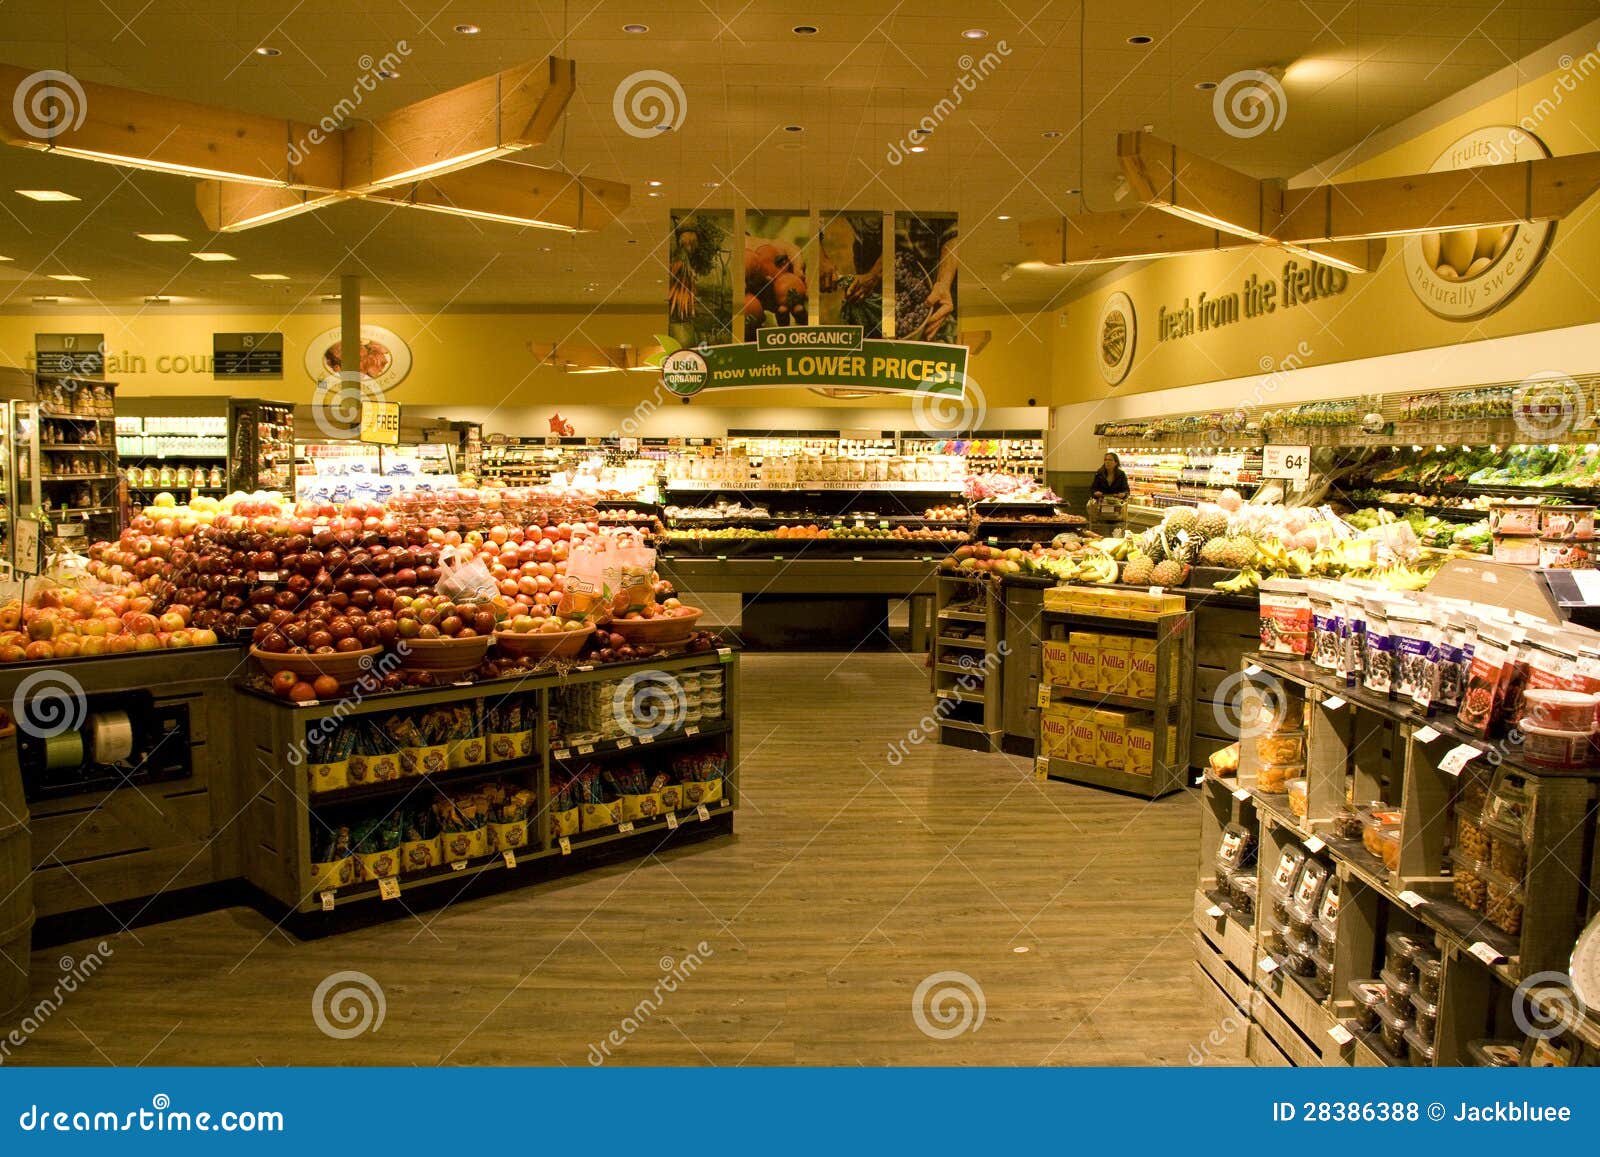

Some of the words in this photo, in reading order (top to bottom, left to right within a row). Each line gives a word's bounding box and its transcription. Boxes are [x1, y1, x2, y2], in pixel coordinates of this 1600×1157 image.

[1452, 141, 1490, 168] fruits
[1415, 265, 1476, 308] naturally
[1483, 232, 1531, 297] sweet
[1158, 298, 1194, 342] fresh
[1198, 291, 1239, 332] from
[1244, 273, 1276, 318] the
[64, 336, 75, 348] 17
[242, 335, 254, 347] 18
[766, 333, 787, 345] GO
[789, 331, 853, 345] ORGANIC!
[107, 350, 147, 373] ain
[672, 360, 698, 371] USDA
[713, 368, 745, 380] now
[748, 363, 782, 377] with
[786, 356, 866, 378] LOWER
[872, 357, 956, 385] PRICES!
[669, 374, 702, 384] ORGANIC
[376, 414, 398, 430] FREE
[1044, 647, 1067, 662] Nilla
[1072, 651, 1095, 665] Nilla
[1101, 654, 1125, 669] Nilla
[1131, 658, 1155, 673] Nilla
[1042, 719, 1065, 735] Nilla
[1071, 724, 1094, 740] Nilla
[1100, 728, 1123, 745] Nilla
[1127, 733, 1152, 750] Nilla
